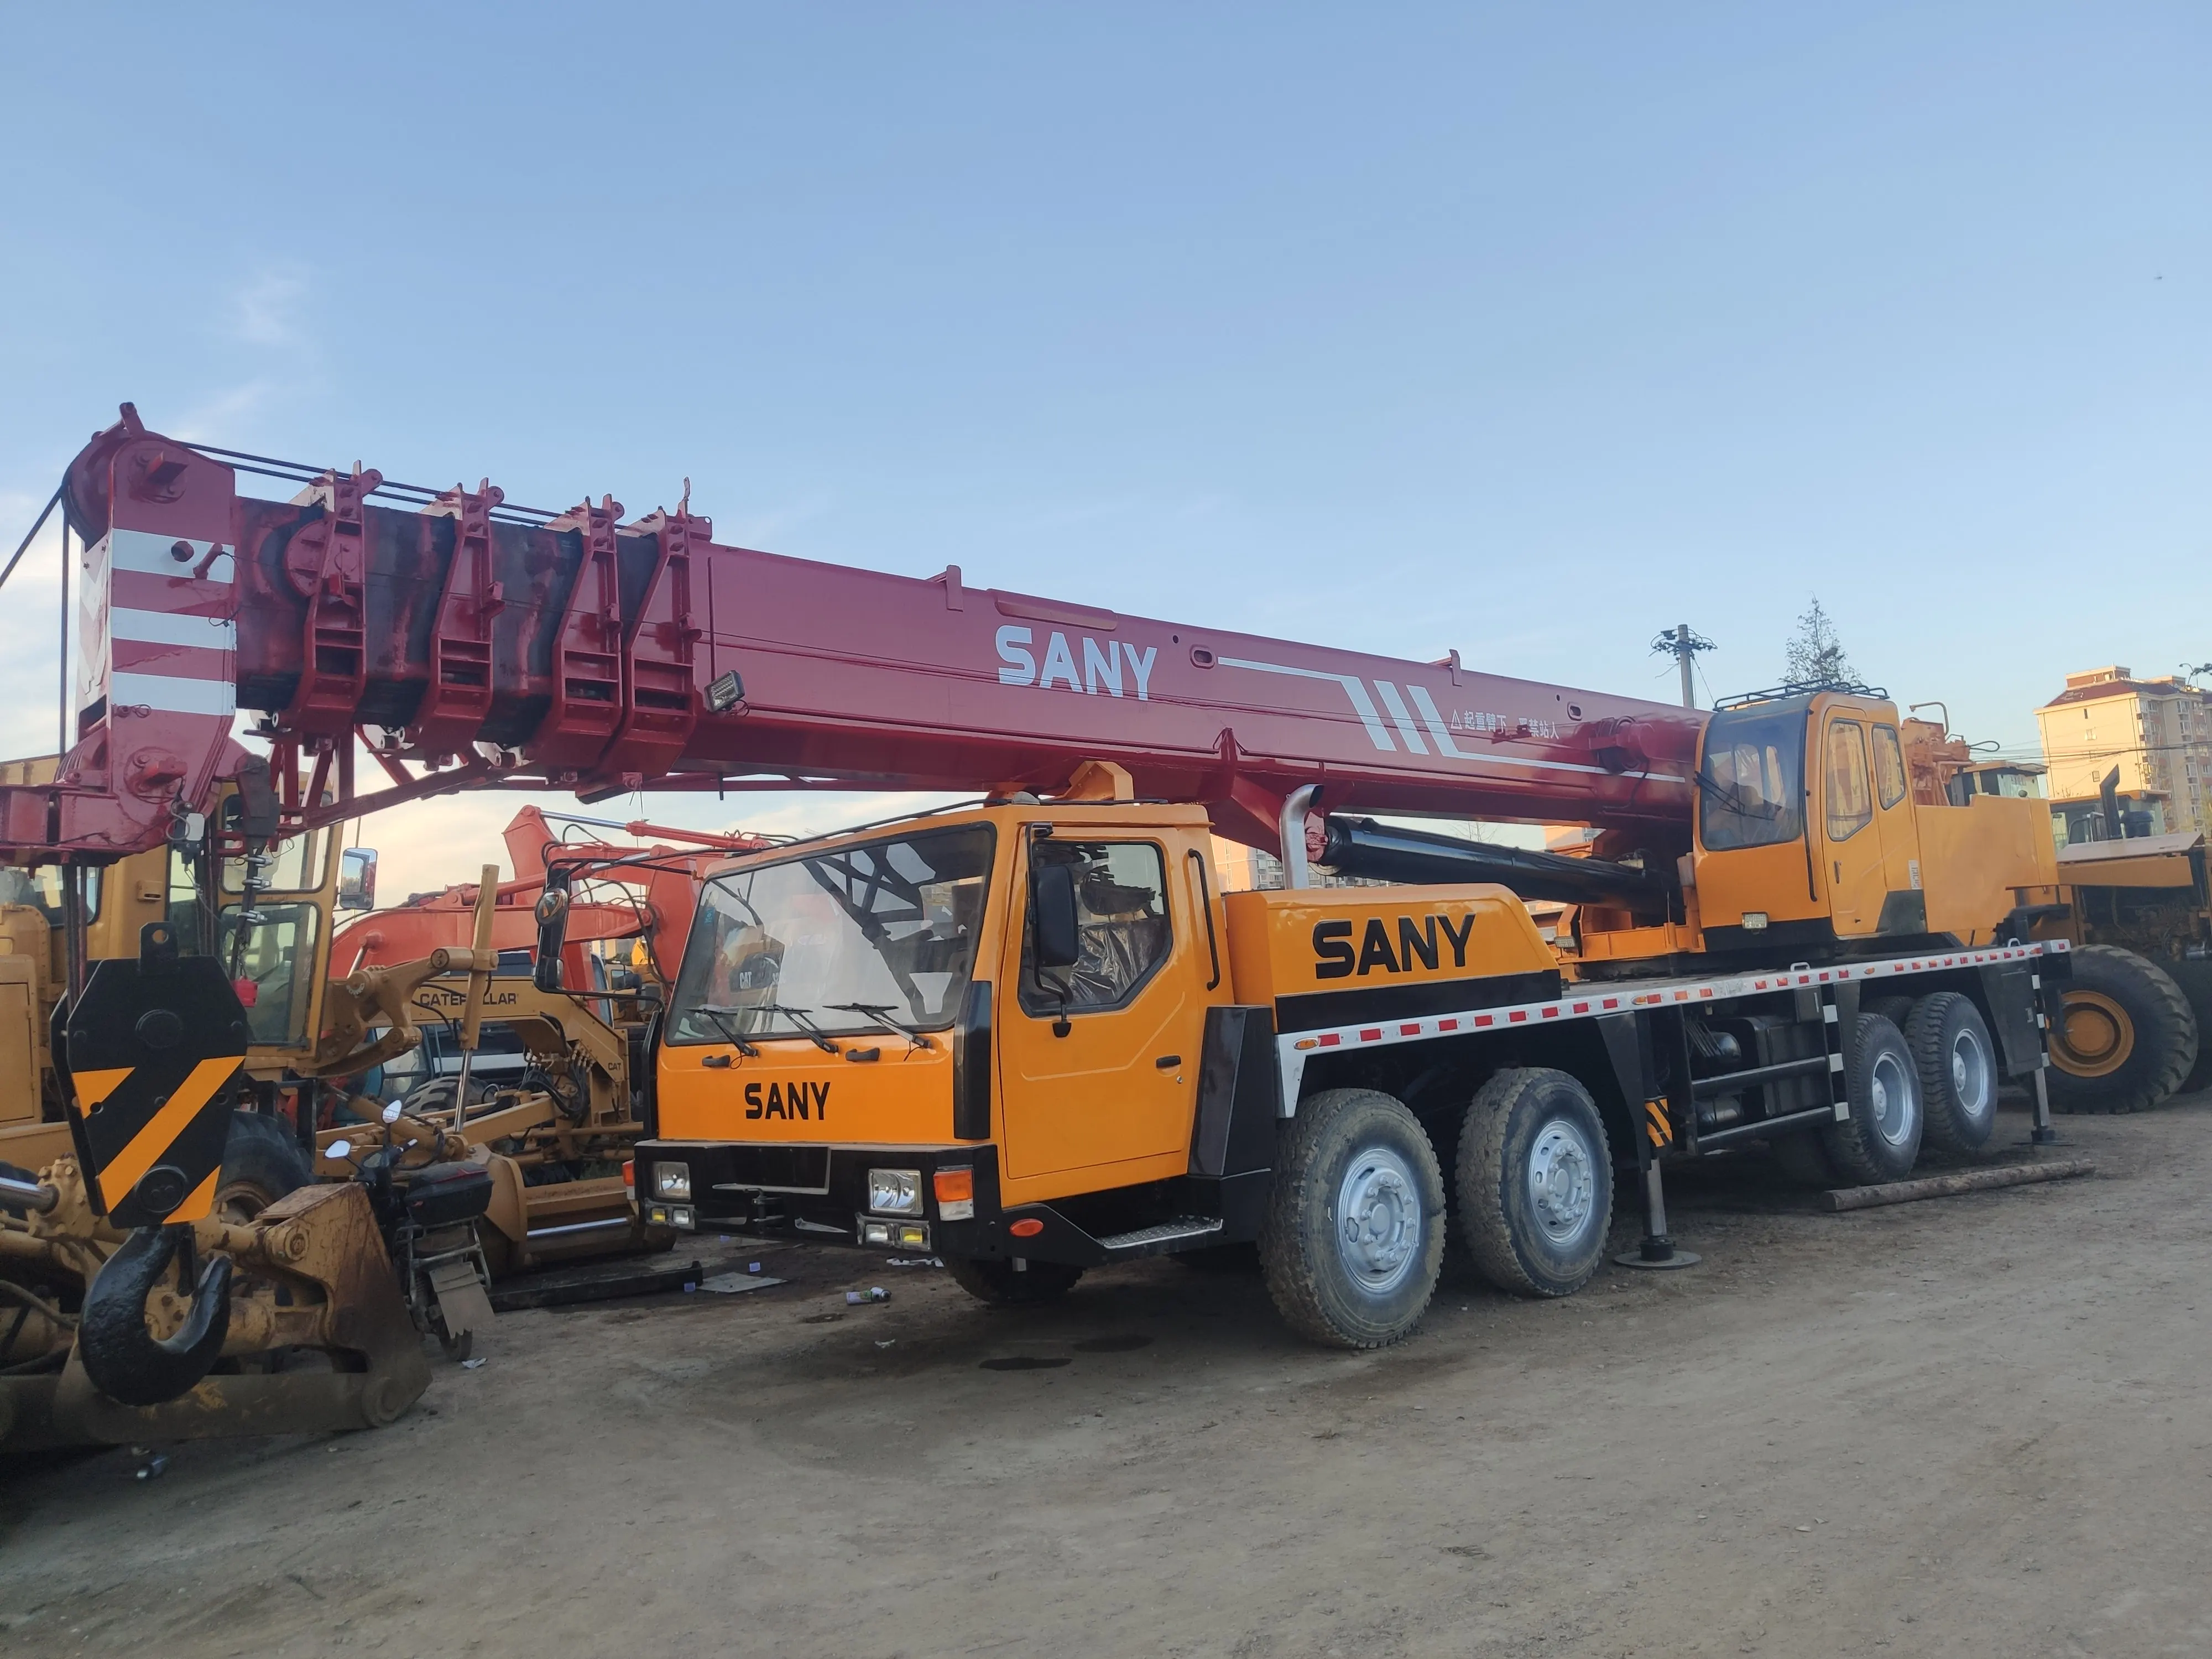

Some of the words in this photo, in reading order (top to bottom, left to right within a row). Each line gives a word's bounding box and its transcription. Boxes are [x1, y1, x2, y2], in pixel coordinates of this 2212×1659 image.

[995, 624, 1158, 701] SANY
[1464, 710, 1506, 734] 起重臂下
[1312, 913, 1476, 979] SANY
[420, 993, 517, 1006] CATERLLAR
[744, 1082, 831, 1120] SANY
